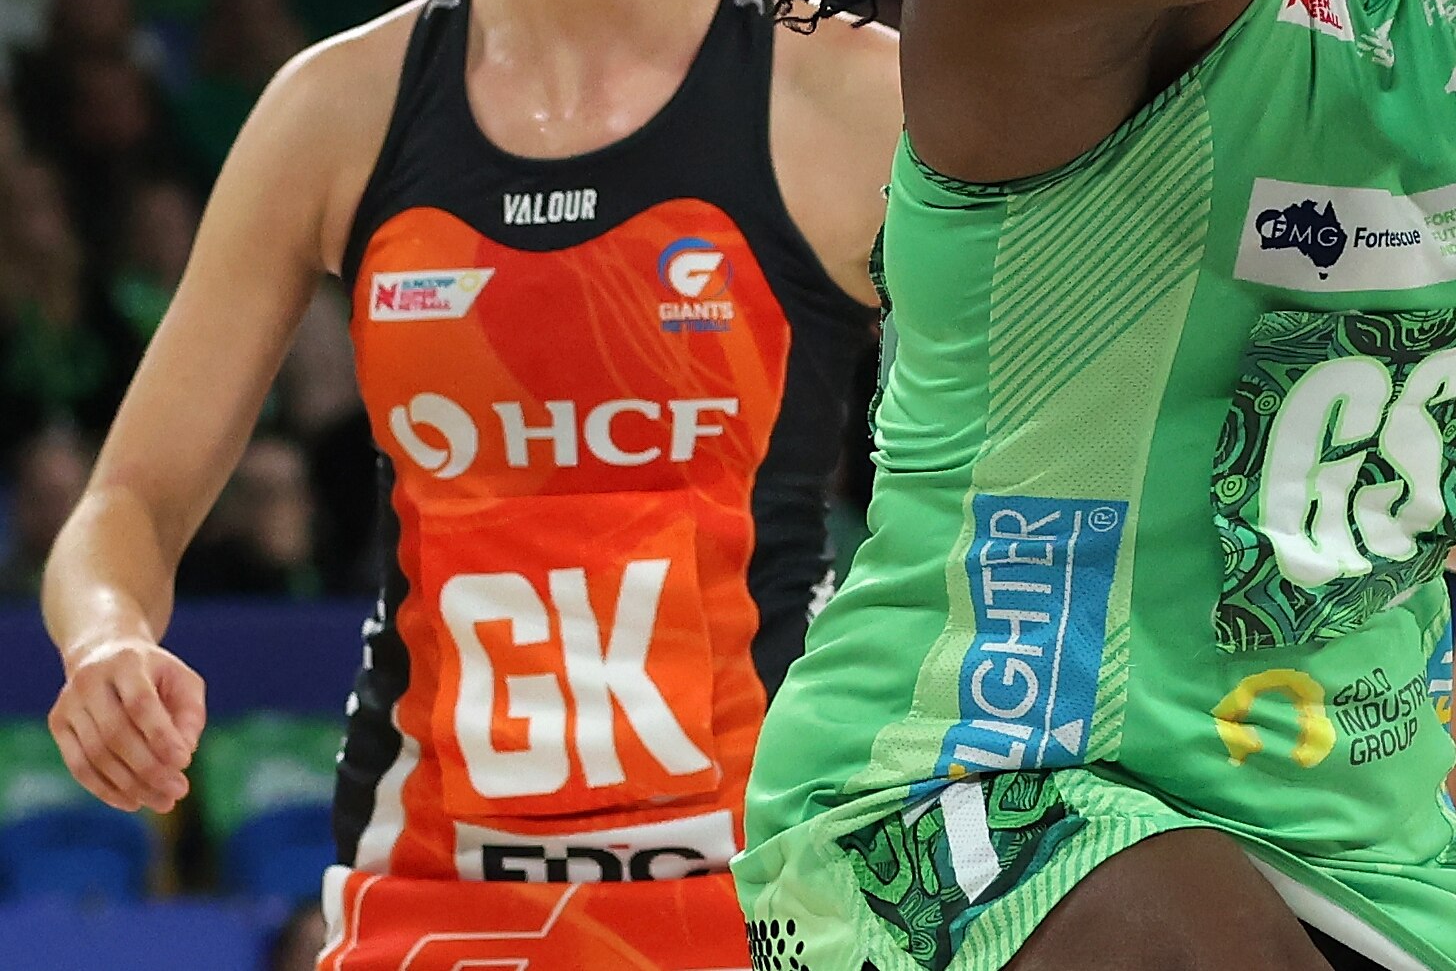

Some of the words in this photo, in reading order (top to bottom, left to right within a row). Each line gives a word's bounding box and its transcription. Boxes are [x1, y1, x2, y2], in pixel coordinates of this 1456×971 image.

[503, 188, 598, 225] VALOUR
[1353, 227, 1421, 249] Fortescue
[658, 302, 735, 321] GIANTS
[491, 397, 740, 469] HCF
[952, 508, 1063, 770] LIGHTER
[439, 558, 714, 799] GK
[1332, 667, 1392, 707] GOLD
[1335, 669, 1430, 737] INDUSTRY
[1349, 717, 1418, 766] GROUP
